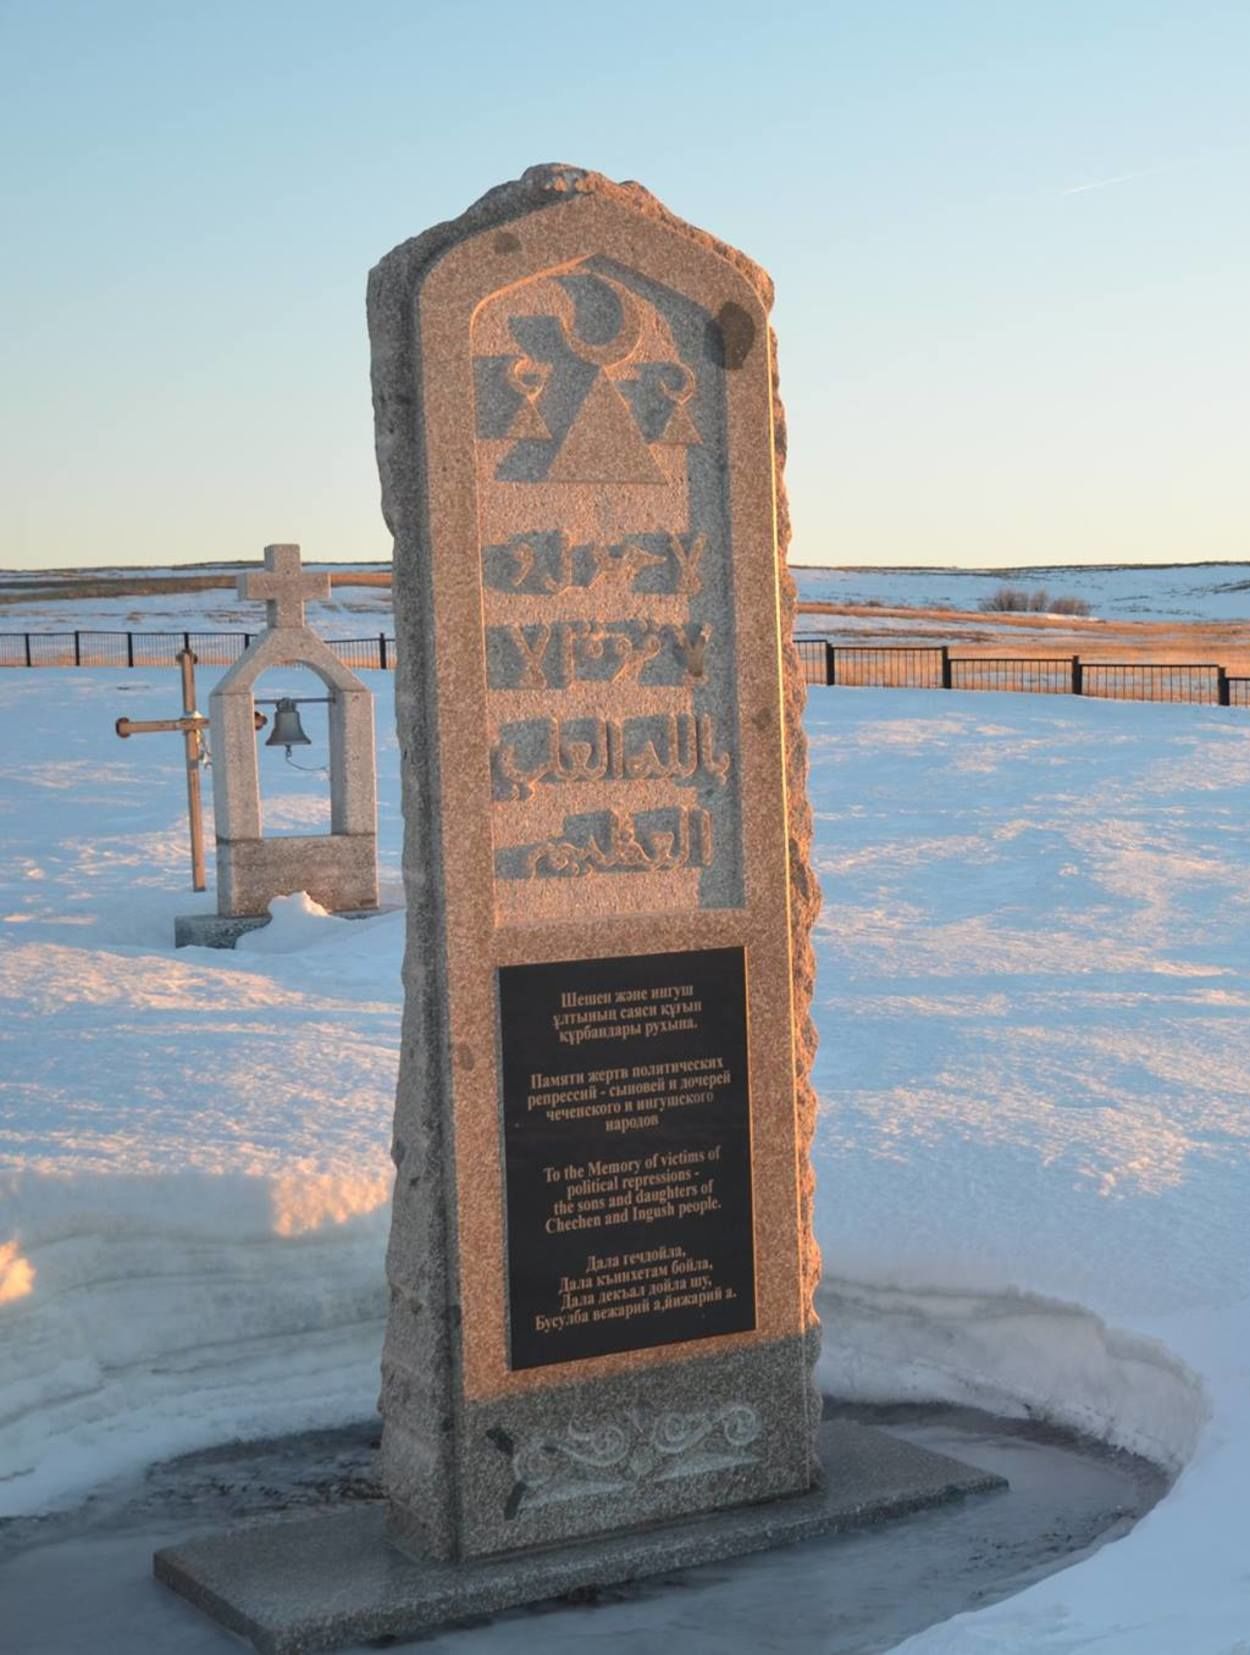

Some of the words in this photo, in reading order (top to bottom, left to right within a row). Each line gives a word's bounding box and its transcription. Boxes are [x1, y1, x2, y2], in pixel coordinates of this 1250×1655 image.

[561, 991, 612, 1008] Шешен
[615, 988, 649, 1002] және
[651, 985, 694, 1001] ингуш
[620, 1005, 657, 1019] саяси
[530, 1072, 585, 1089] Памяти
[588, 1066, 629, 1086] жертв
[632, 1057, 724, 1077] политических
[527, 1085, 597, 1111] репрессий
[609, 1079, 665, 1097] сыновей
[668, 1079, 678, 1091] и
[680, 1070, 731, 1090] дочерей
[546, 1103, 621, 1121] чеченского
[624, 1101, 634, 1113] и
[636, 1092, 715, 1112] ингушского
[605, 1113, 659, 1134] народов
[543, 1167, 560, 1183] To
[564, 1164, 585, 1180] the
[588, 1160, 641, 1177] Memory
[645, 1153, 659, 1169] of
[660, 1150, 705, 1166] victims
[708, 1145, 721, 1161] of
[554, 1200, 575, 1216] the
[577, 1198, 605, 1212] sons
[608, 1191, 632, 1208] and
[636, 1184, 698, 1206] daughters
[700, 1179, 715, 1194] of
[567, 1176, 618, 1200] political
[622, 1168, 691, 1191] repressions
[545, 1214, 601, 1235] Chechen
[604, 1208, 629, 1225] and
[632, 1202, 675, 1223] Ingush
[678, 1196, 722, 1219] people.
[585, 1255, 620, 1273] Дала
[558, 1277, 593, 1296] Дала
[560, 1293, 595, 1312] Дала
[648, 1278, 687, 1296] дойла
